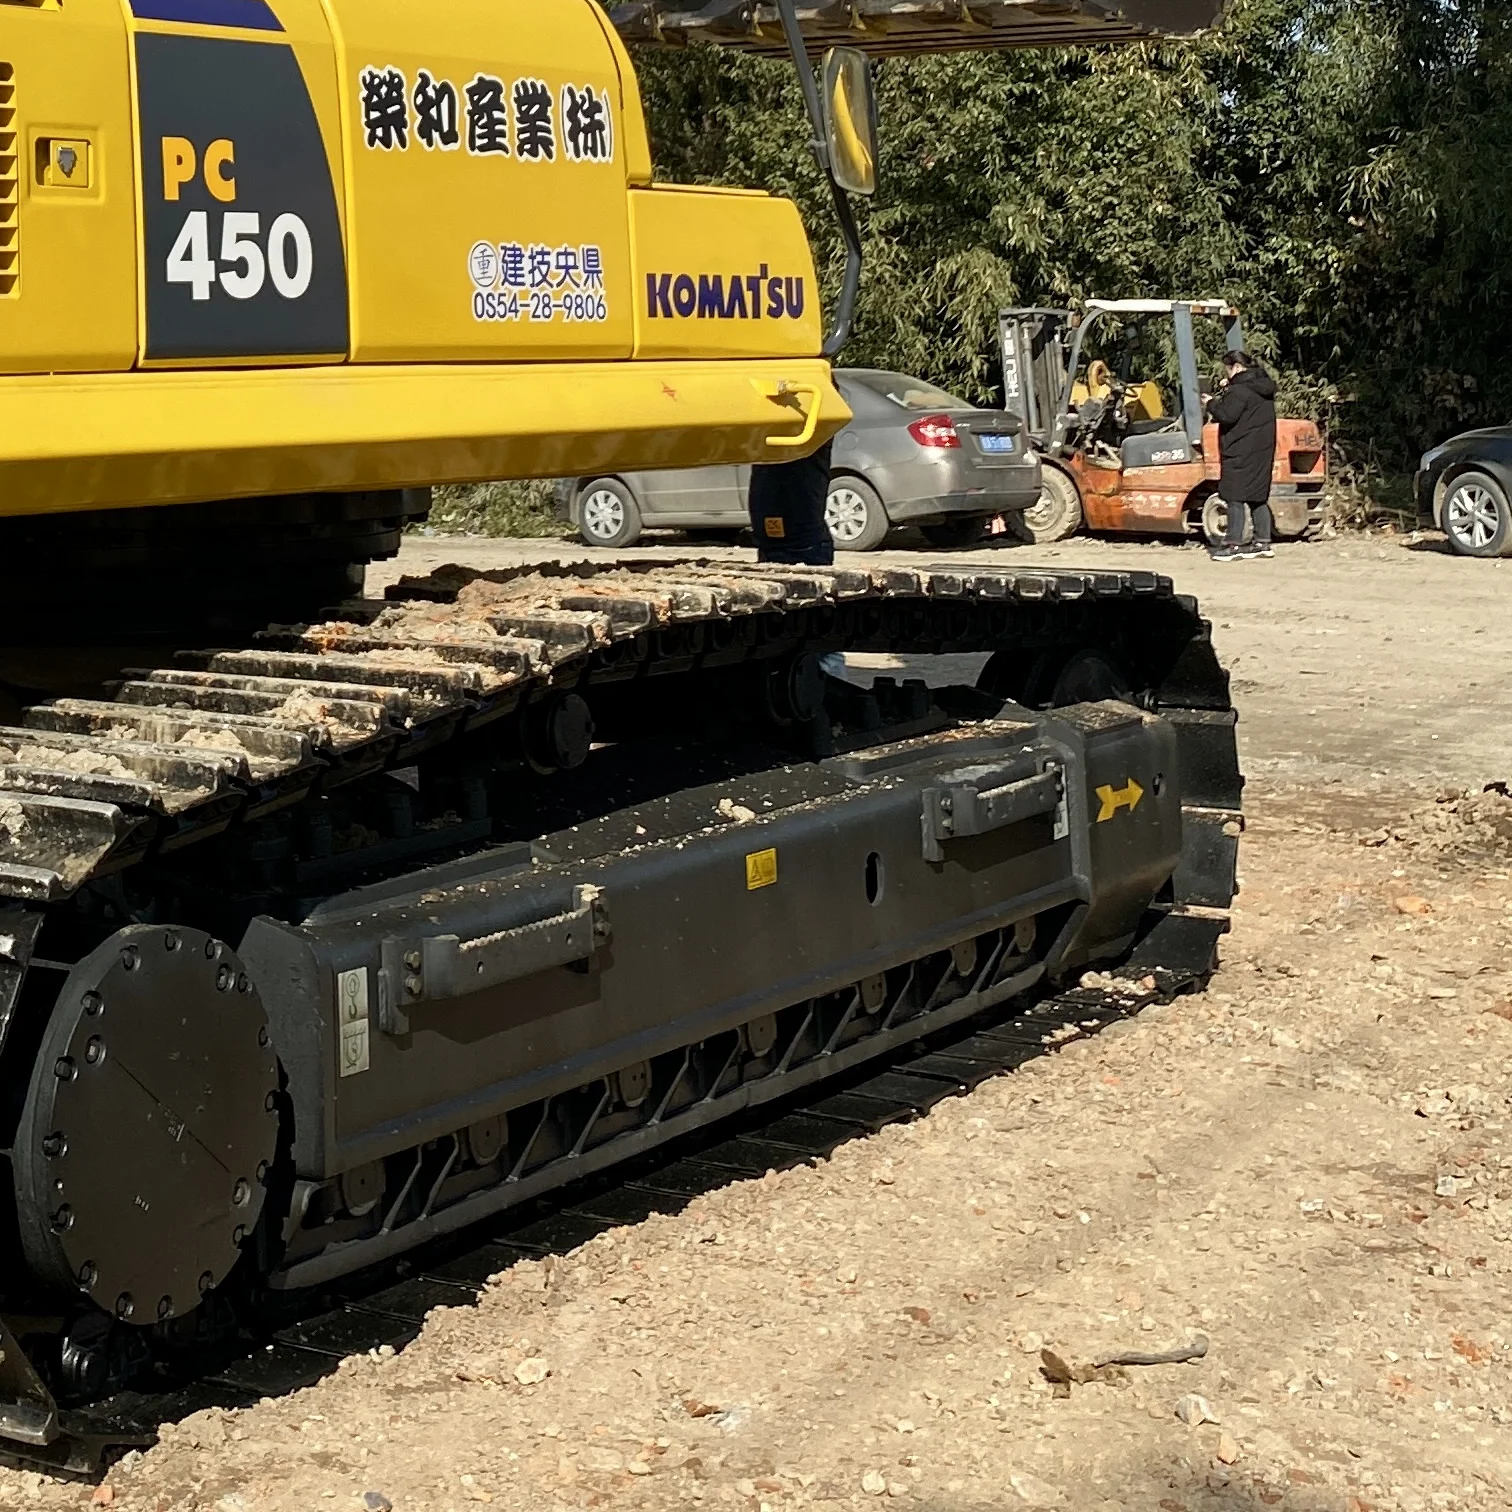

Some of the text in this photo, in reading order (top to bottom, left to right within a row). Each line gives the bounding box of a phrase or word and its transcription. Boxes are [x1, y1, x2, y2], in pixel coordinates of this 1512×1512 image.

[161, 136, 236, 202] PC
[166, 211, 313, 301] 450
[646, 263, 804, 319] KOMATSU
